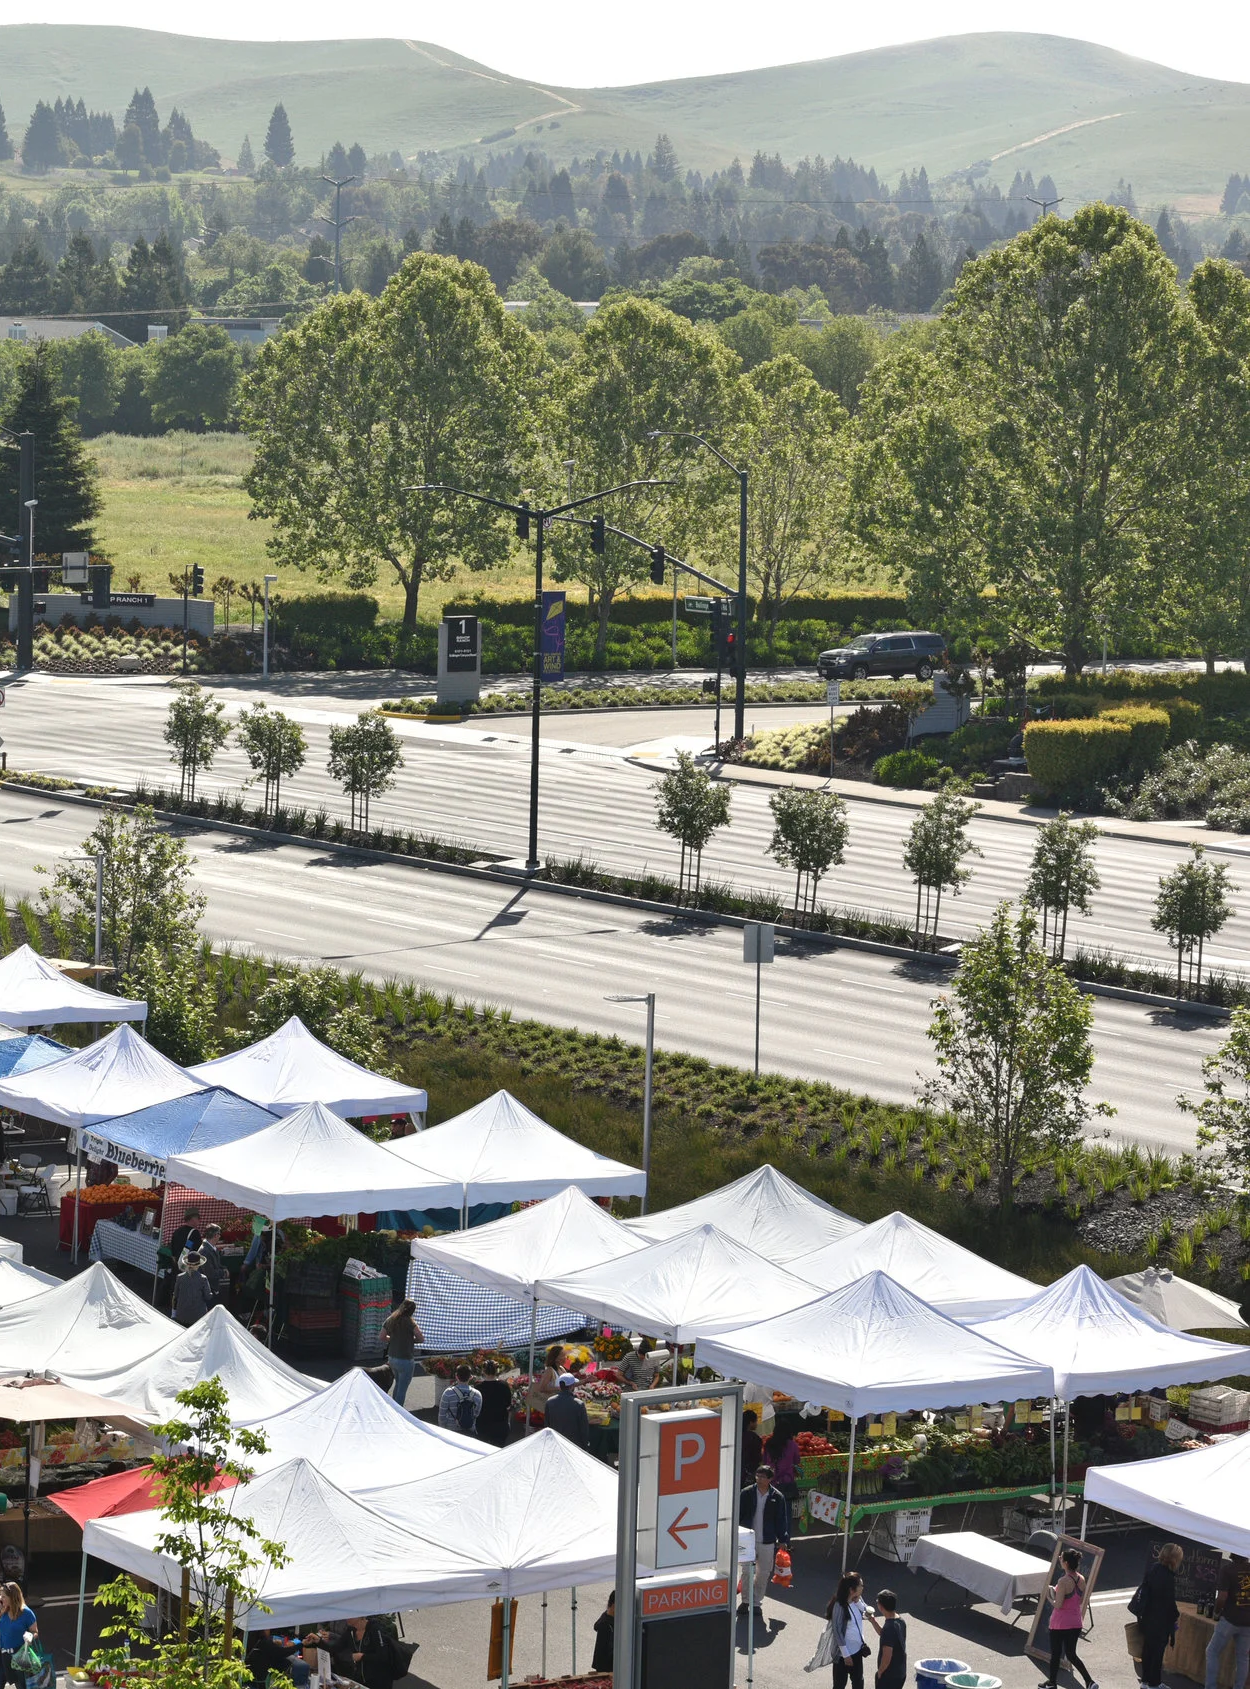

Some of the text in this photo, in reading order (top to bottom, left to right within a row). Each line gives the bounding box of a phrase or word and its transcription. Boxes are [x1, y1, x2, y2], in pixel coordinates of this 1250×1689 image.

[458, 619, 466, 634] 1
[544, 656, 562, 664] ART &
[674, 1432, 706, 1482] P
[648, 1584, 724, 1610] PARKING
